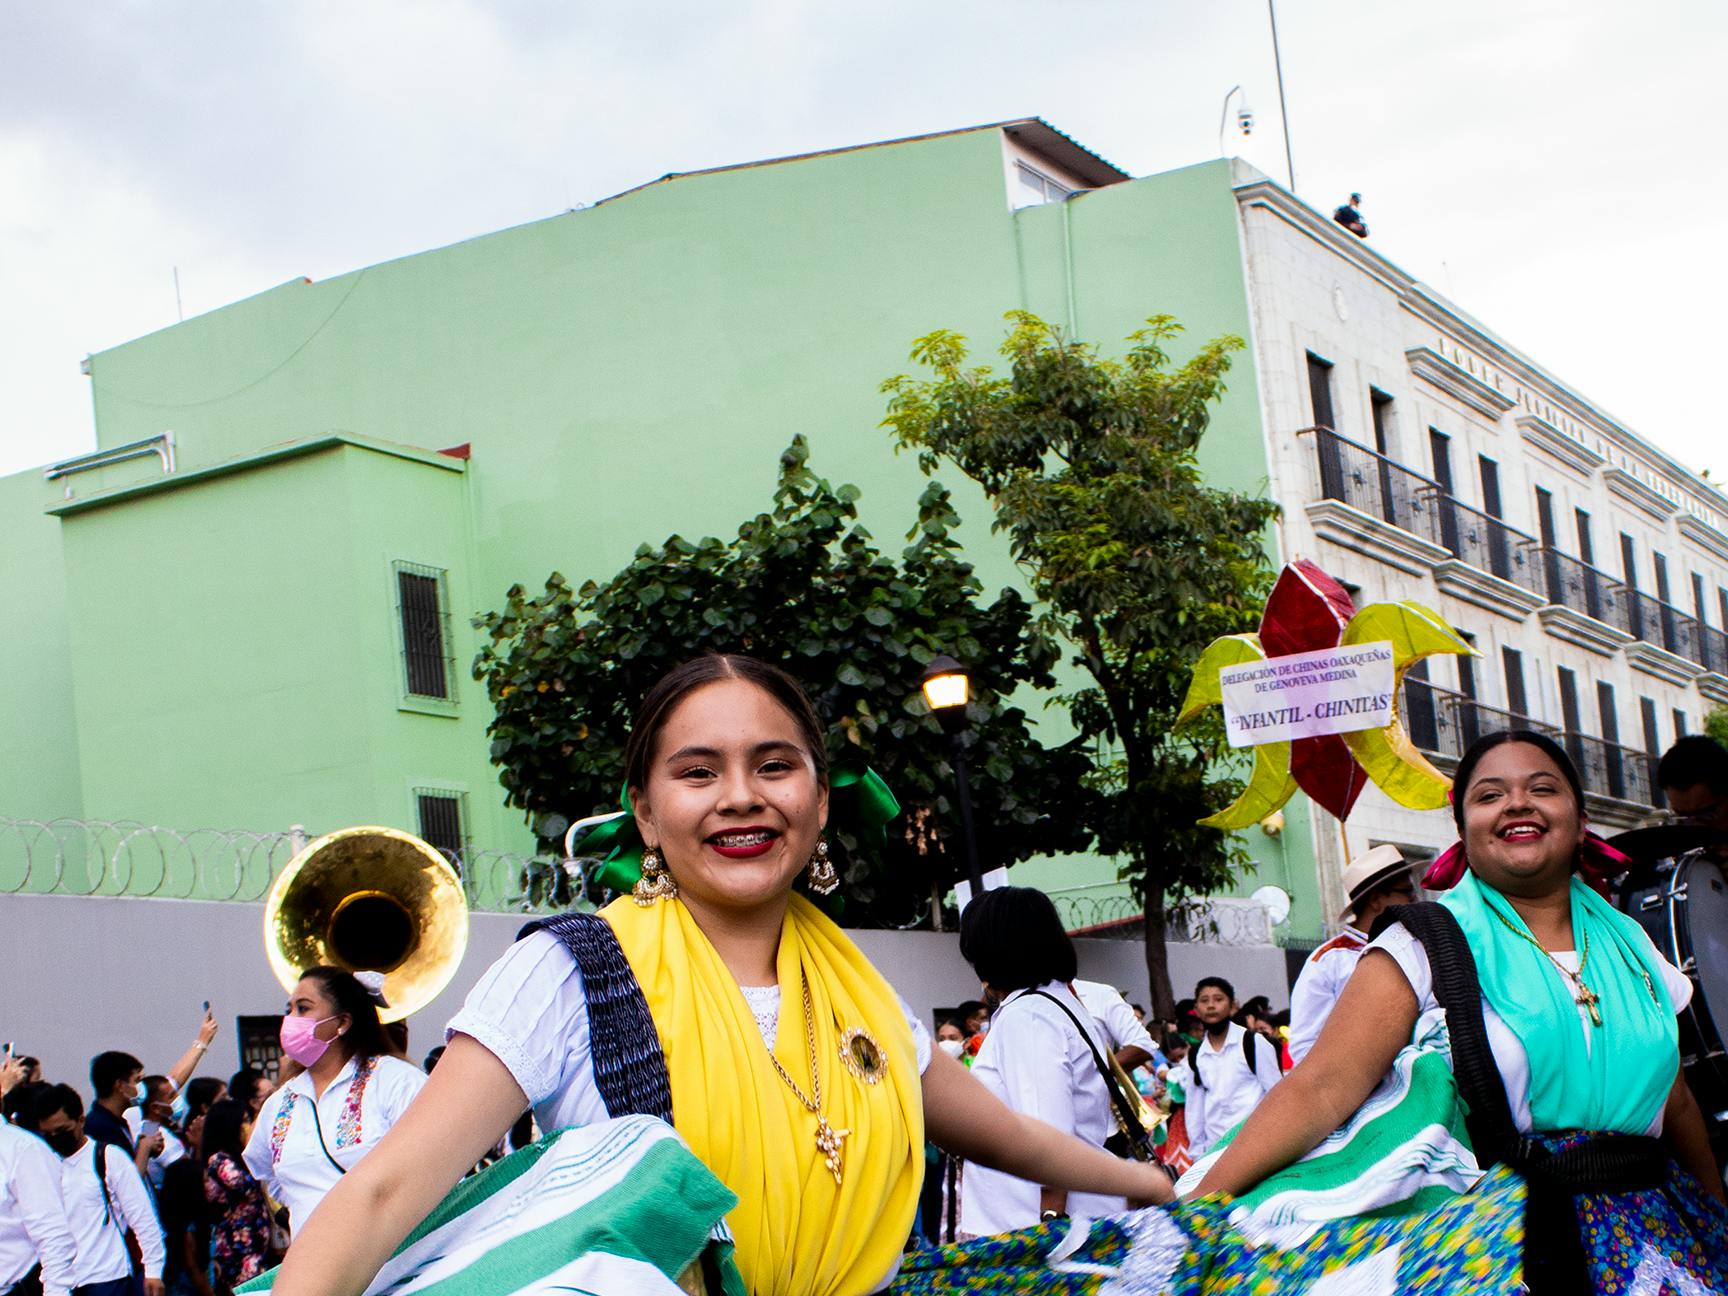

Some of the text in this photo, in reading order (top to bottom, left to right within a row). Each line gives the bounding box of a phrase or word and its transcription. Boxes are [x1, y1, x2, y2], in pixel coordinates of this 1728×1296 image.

[1278, 664, 1292, 676] DE
[1292, 659, 1328, 674] CHINAS
[1330, 648, 1391, 668] OAXAQUEÑAS
[1254, 669, 1357, 693] DE GENOVEVA MEDINA
